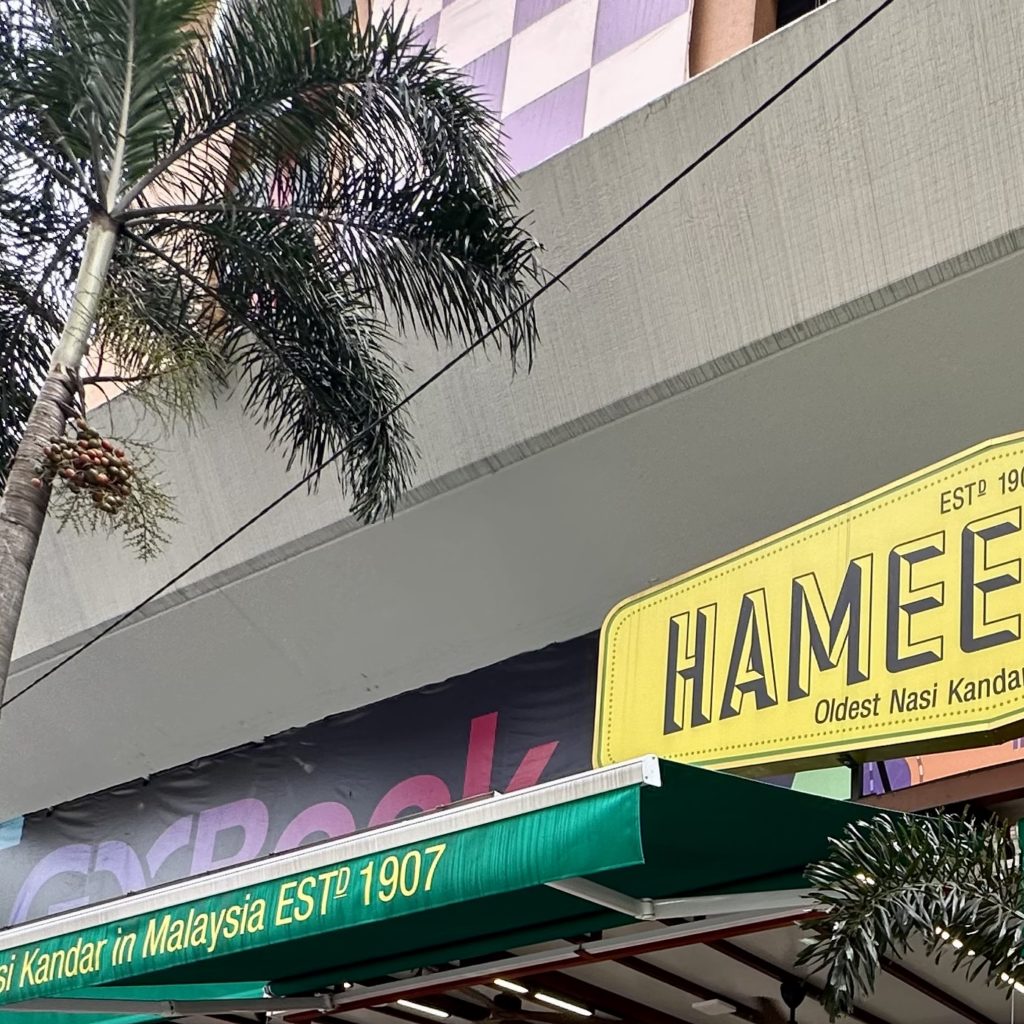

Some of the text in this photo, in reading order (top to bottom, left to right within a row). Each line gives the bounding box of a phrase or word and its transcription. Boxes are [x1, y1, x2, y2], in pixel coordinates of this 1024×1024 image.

[815, 689, 880, 725] Oldest
[890, 682, 937, 714] Nasi
[19, 937, 108, 988] Kandar
[111, 931, 137, 967] in
[142, 893, 265, 960] Malaysia
[361, 844, 447, 907] 1907
